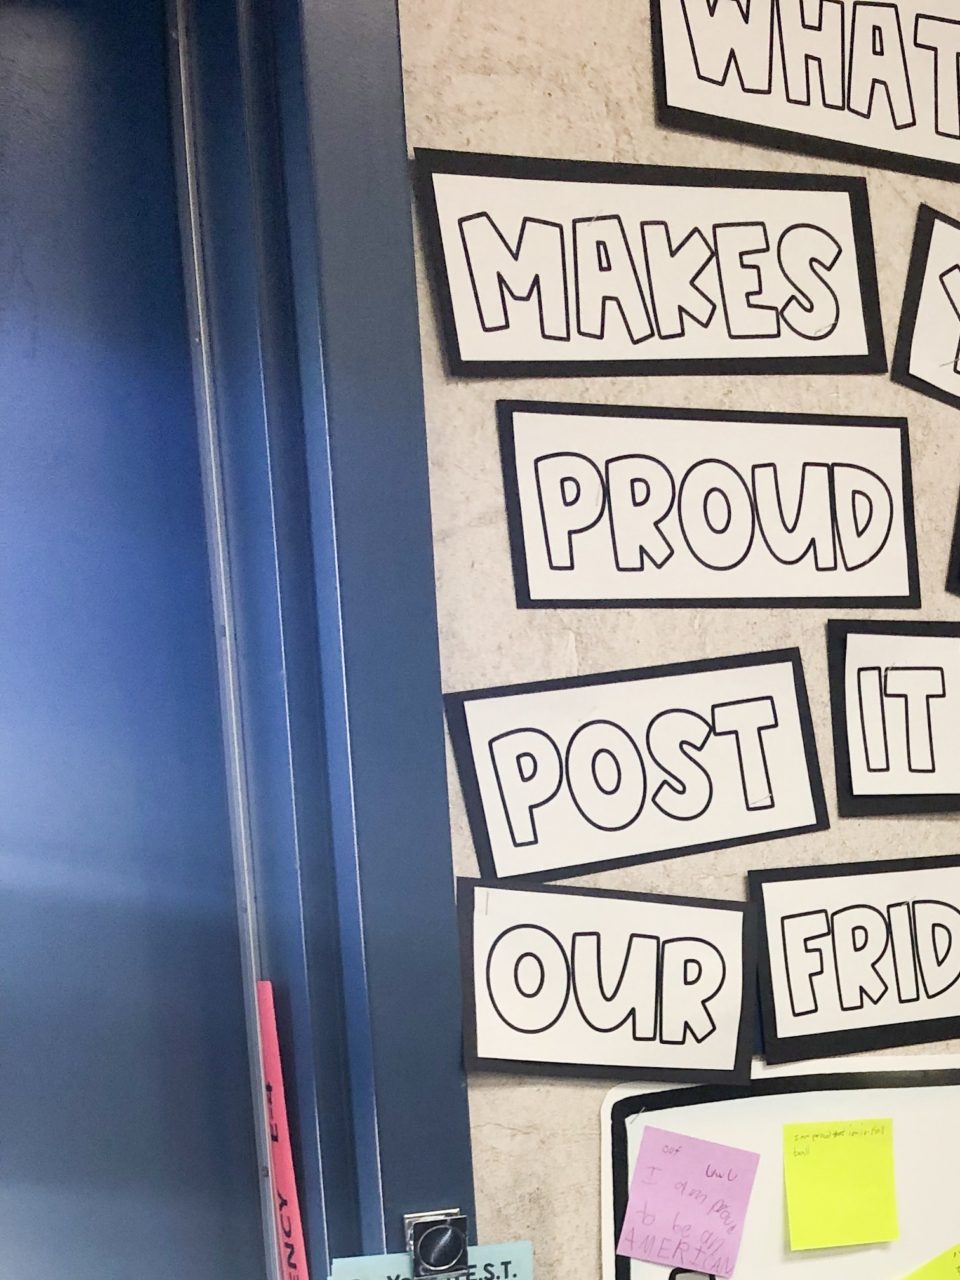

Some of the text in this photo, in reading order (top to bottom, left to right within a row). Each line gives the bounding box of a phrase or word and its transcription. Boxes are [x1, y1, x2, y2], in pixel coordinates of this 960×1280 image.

[457, 211, 843, 345] MAKES
[534, 451, 894, 573] PROUD
[488, 695, 779, 847] POST
[856, 666, 946, 773] IT
[487, 924, 727, 1045] OUR
